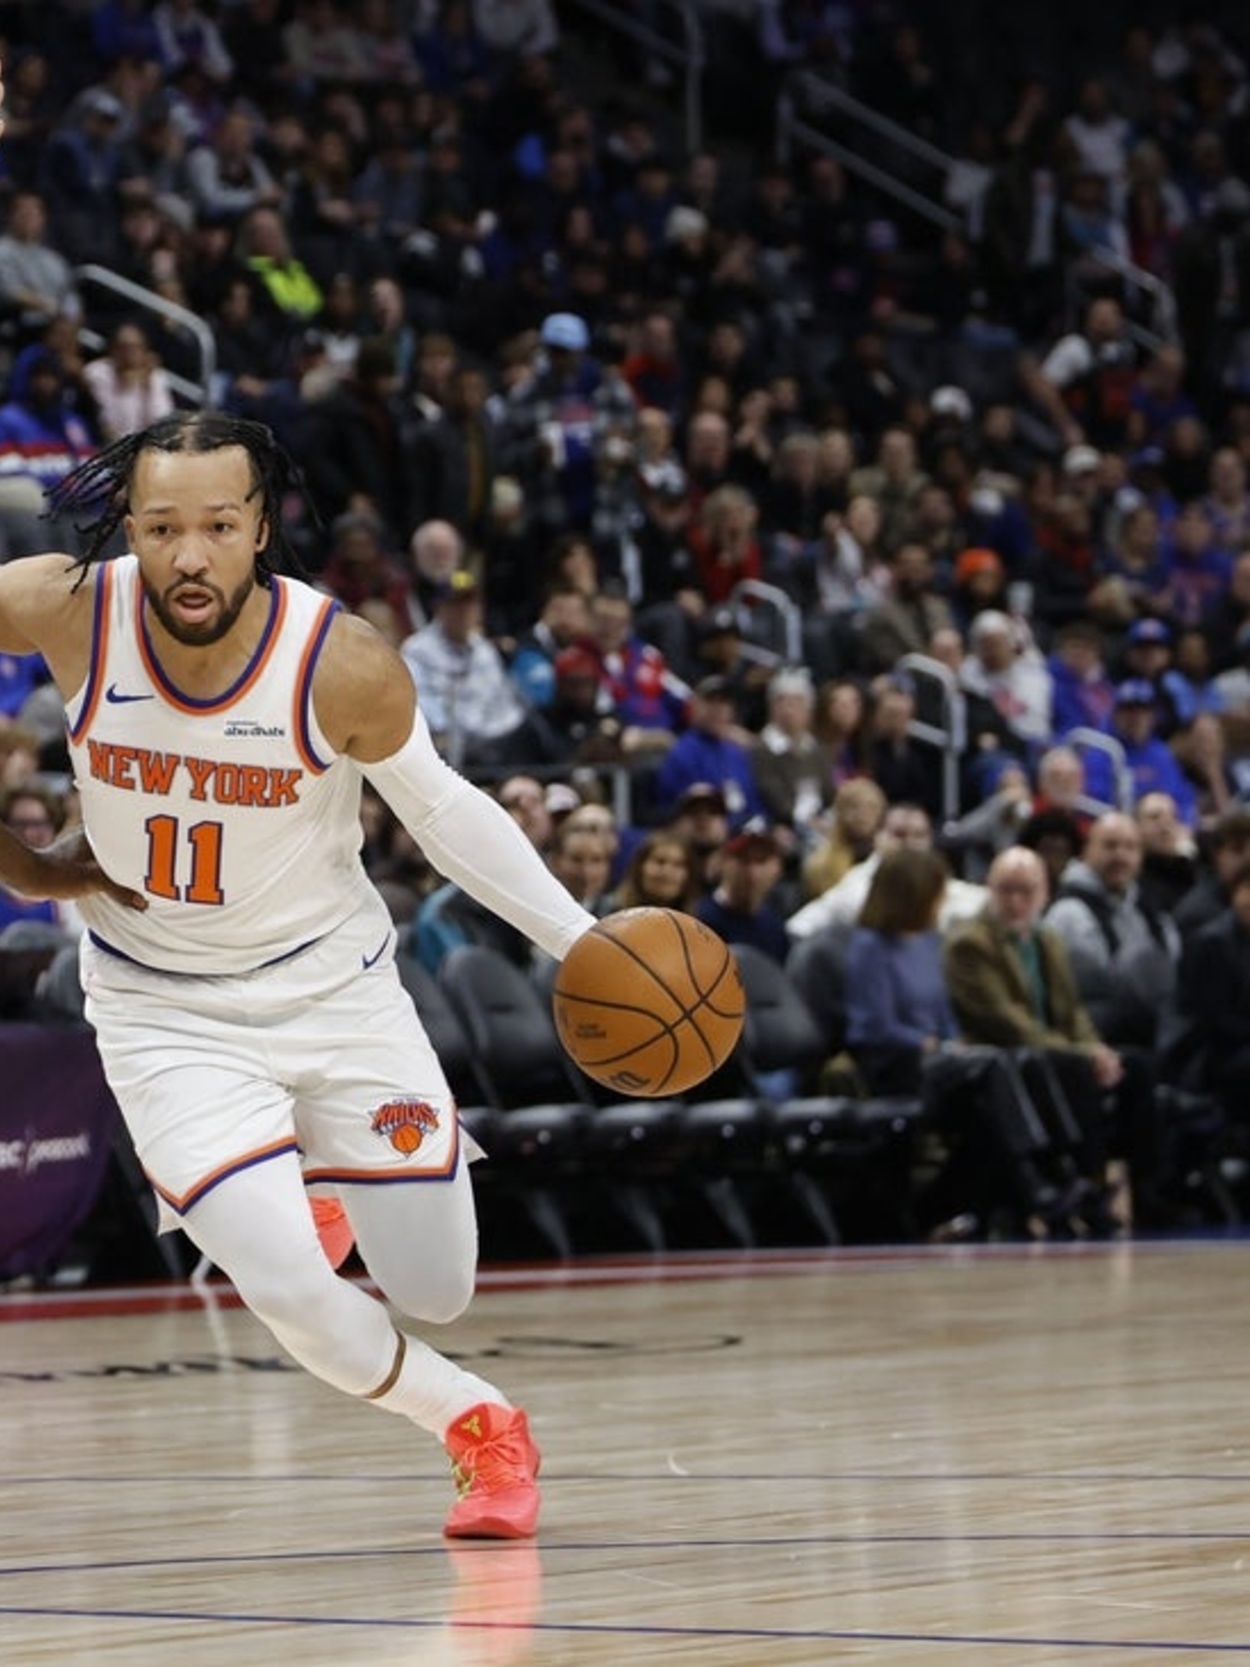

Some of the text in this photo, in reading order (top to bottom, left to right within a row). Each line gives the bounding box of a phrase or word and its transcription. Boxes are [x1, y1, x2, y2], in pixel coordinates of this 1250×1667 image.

[87, 738, 303, 808] NEW YORK
[144, 813, 225, 906] 11
